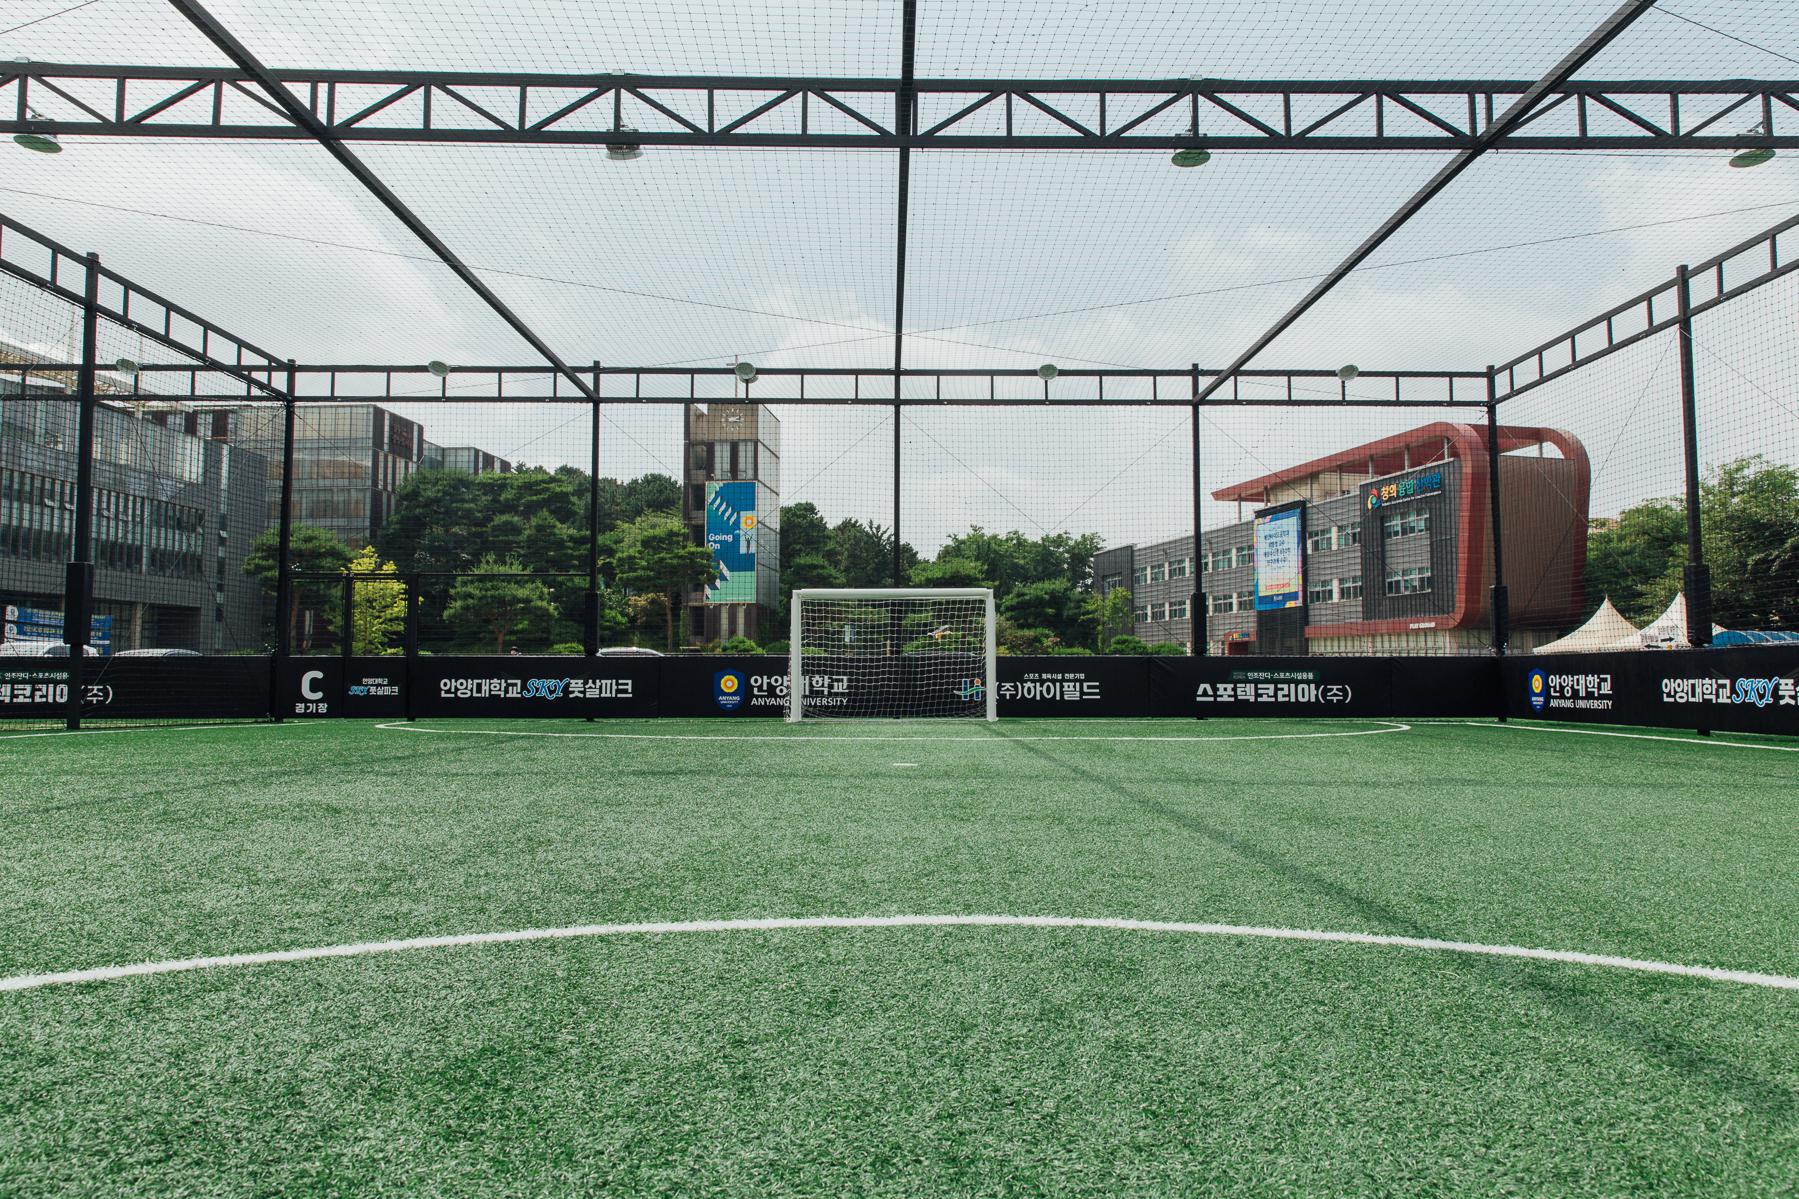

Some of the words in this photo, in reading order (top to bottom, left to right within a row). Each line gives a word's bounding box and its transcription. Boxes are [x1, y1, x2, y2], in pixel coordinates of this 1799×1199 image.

[708, 533, 733, 542] Going
[708, 542, 721, 550] On
[301, 670, 324, 700] C
[439, 678, 521, 698] 안양대학교
[522, 677, 571, 700] SKY
[568, 679, 632, 698] 풋살파크
[1548, 674, 1612, 697] 안양대학교
[1661, 677, 1732, 703] 안양대학교
[1731, 676, 1780, 708] SKY
[1778, 678, 1799, 706] 풋
[751, 697, 791, 706] ANYANG
[801, 697, 848, 706] NIVERSITY
[1196, 683, 1352, 704] 스포텍코리아(주)
[295, 703, 328, 713] 경기장
[1549, 698, 1575, 708] ANYANG
[1575, 699, 1612, 710] UNIVERSITY
